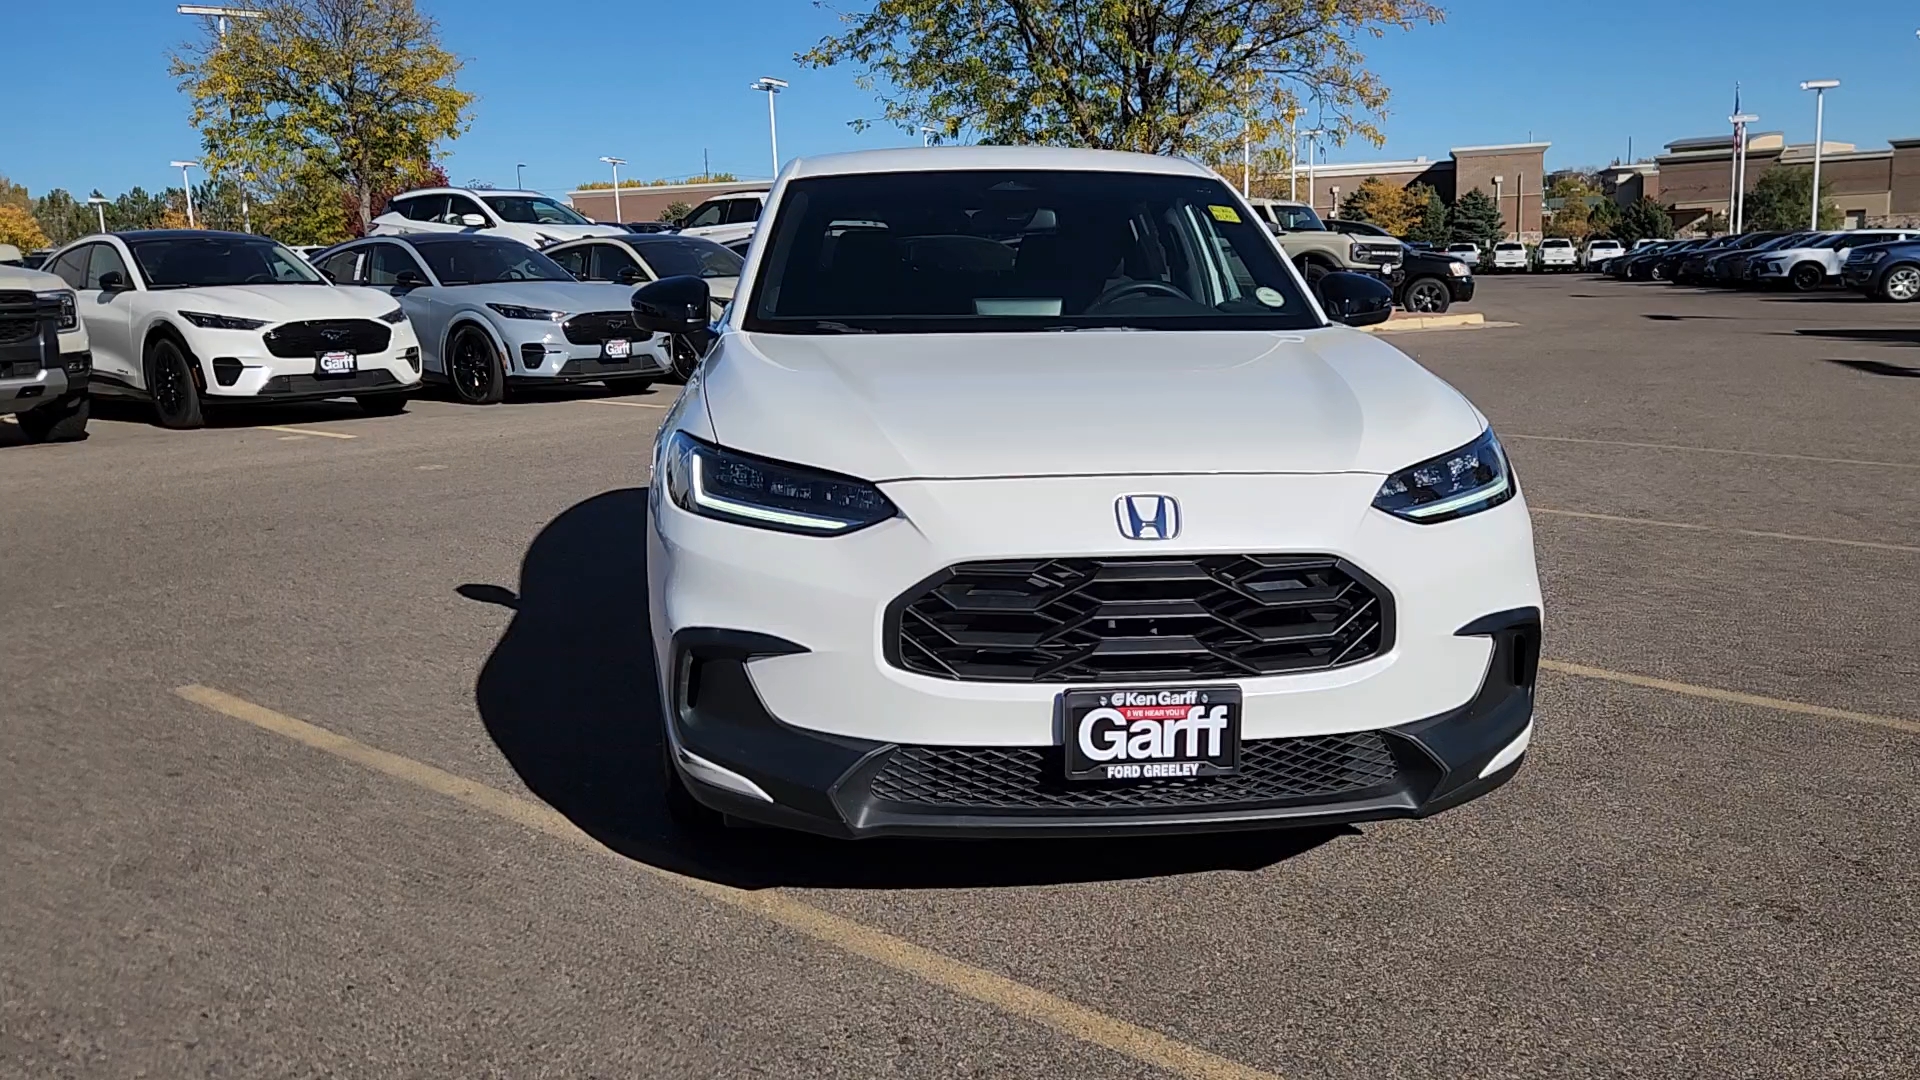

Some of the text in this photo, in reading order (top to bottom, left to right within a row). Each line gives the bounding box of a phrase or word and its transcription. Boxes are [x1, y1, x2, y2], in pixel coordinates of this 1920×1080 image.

[320, 354, 354, 370] Garff
[1125, 692, 1157, 706] Ken
[1157, 691, 1198, 705] Garff
[1144, 709, 1165, 717] HEAR
[1078, 705, 1228, 761] Garff
[1107, 763, 1199, 779] FORD GREELEY
